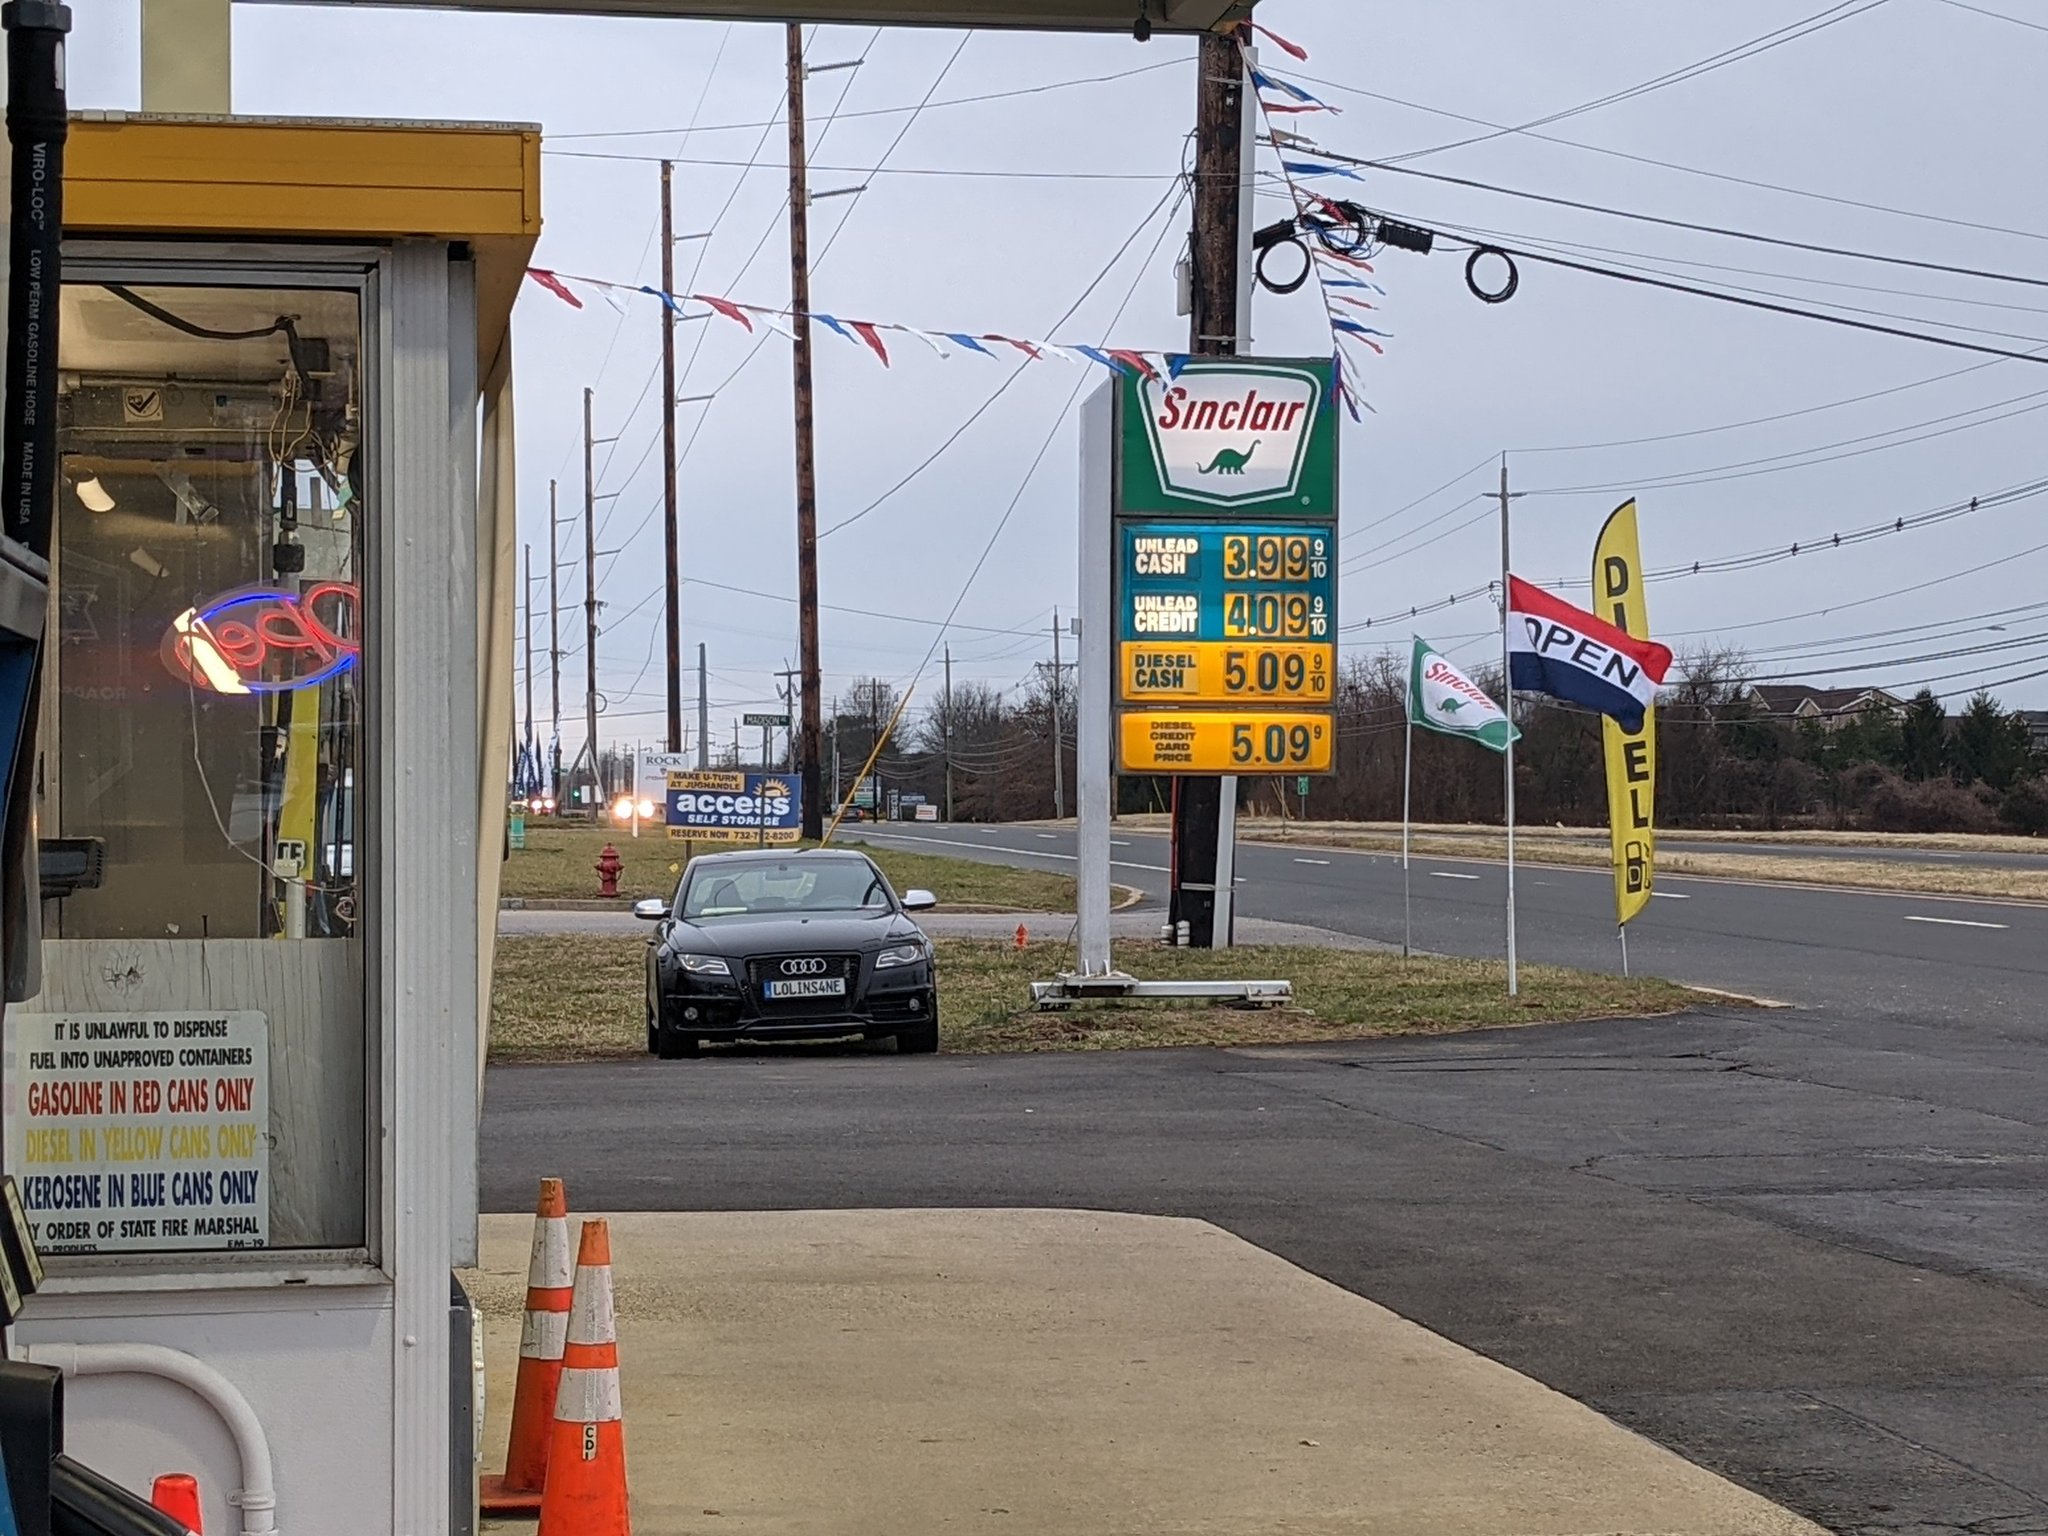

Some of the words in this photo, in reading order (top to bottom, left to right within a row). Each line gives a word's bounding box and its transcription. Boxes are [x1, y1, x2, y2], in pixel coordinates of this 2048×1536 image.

[30, 249, 41, 279] LOW
[29, 281, 41, 319] PERM
[26, 322, 39, 387] GASOLINE
[24, 390, 36, 426] HOSE
[1158, 387, 1305, 431] Sinclair
[22, 442, 34, 479] MADE
[21, 482, 31, 496] IN
[19, 498, 30, 525] USA
[1134, 538, 1199, 554] UNLEAD
[1135, 553, 1186, 575] CASH
[1226, 538, 1308, 578] 3.99
[1134, 596, 1197, 612] UNLEAD
[1134, 611, 1198, 633] CREDIT
[1227, 595, 1308, 635] 4.09
[1135, 654, 1197, 668] DIESEL
[1225, 651, 1306, 692] 5.09
[1135, 669, 1184, 689] CASH
[1604, 556, 1650, 829] DIEL
[746, 715, 780, 726] MADISON
[1151, 721, 1196, 730] DIESEL
[1150, 732, 1196, 741] CREDIT
[1313, 725, 1322, 740] 9
[1155, 743, 1190, 751] CARD
[1232, 724, 1310, 764] 5.09
[646, 755, 682, 766] ROCK
[1154, 754, 1192, 763] PRICE
[670, 780, 682, 788] AT
[685, 781, 741, 791] JUGHANDLE
[673, 772, 701, 780] MAKE
[702, 773, 738, 782] U-TURN
[676, 794, 791, 816] access
[687, 814, 719, 825] SELF
[721, 815, 780, 826] STORAGE
[671, 829, 709, 839] RESERVE
[709, 830, 730, 840] NOW
[733, 831, 795, 841] 732-72-8200
[773, 980, 842, 996] LOLINS4NE
[55, 1022, 66, 1040] IT
[69, 1022, 80, 1040] IS
[85, 1020, 149, 1041] UNLAWFUL
[153, 1021, 169, 1039] TO
[173, 1020, 228, 1038] DISPENSE
[30, 1051, 57, 1069] FUEL
[60, 1050, 90, 1069] INTO
[93, 1049, 175, 1069] UNAPPROVED
[179, 1048, 253, 1067] CONTAINERS
[28, 1080, 103, 1117] GASOLINE
[109, 1080, 126, 1115] IN
[133, 1079, 162, 1115] RED
[167, 1078, 209, 1114] CANS
[215, 1077, 255, 1113] ONLY
[26, 1128, 73, 1164] DIESEL
[79, 1127, 97, 1162] IN
[103, 1125, 164, 1162] YELLOW
[169, 1124, 211, 1161] CANS
[217, 1122, 258, 1159] ONLY
[23, 1175, 102, 1211] KEROSENE
[108, 1173, 125, 1209] IN
[131, 1172, 165, 1208] BLUE
[172, 1171, 213, 1206] CANS
[219, 1170, 259, 1205] ONLY
[29, 1222, 40, 1241] Y
[46, 1221, 92, 1240] ORDER
[97, 1220, 115, 1239] OF
[120, 1219, 156, 1238] STATE
[162, 1218, 189, 1237] FIRE
[194, 1216, 260, 1236] MARSHAL
